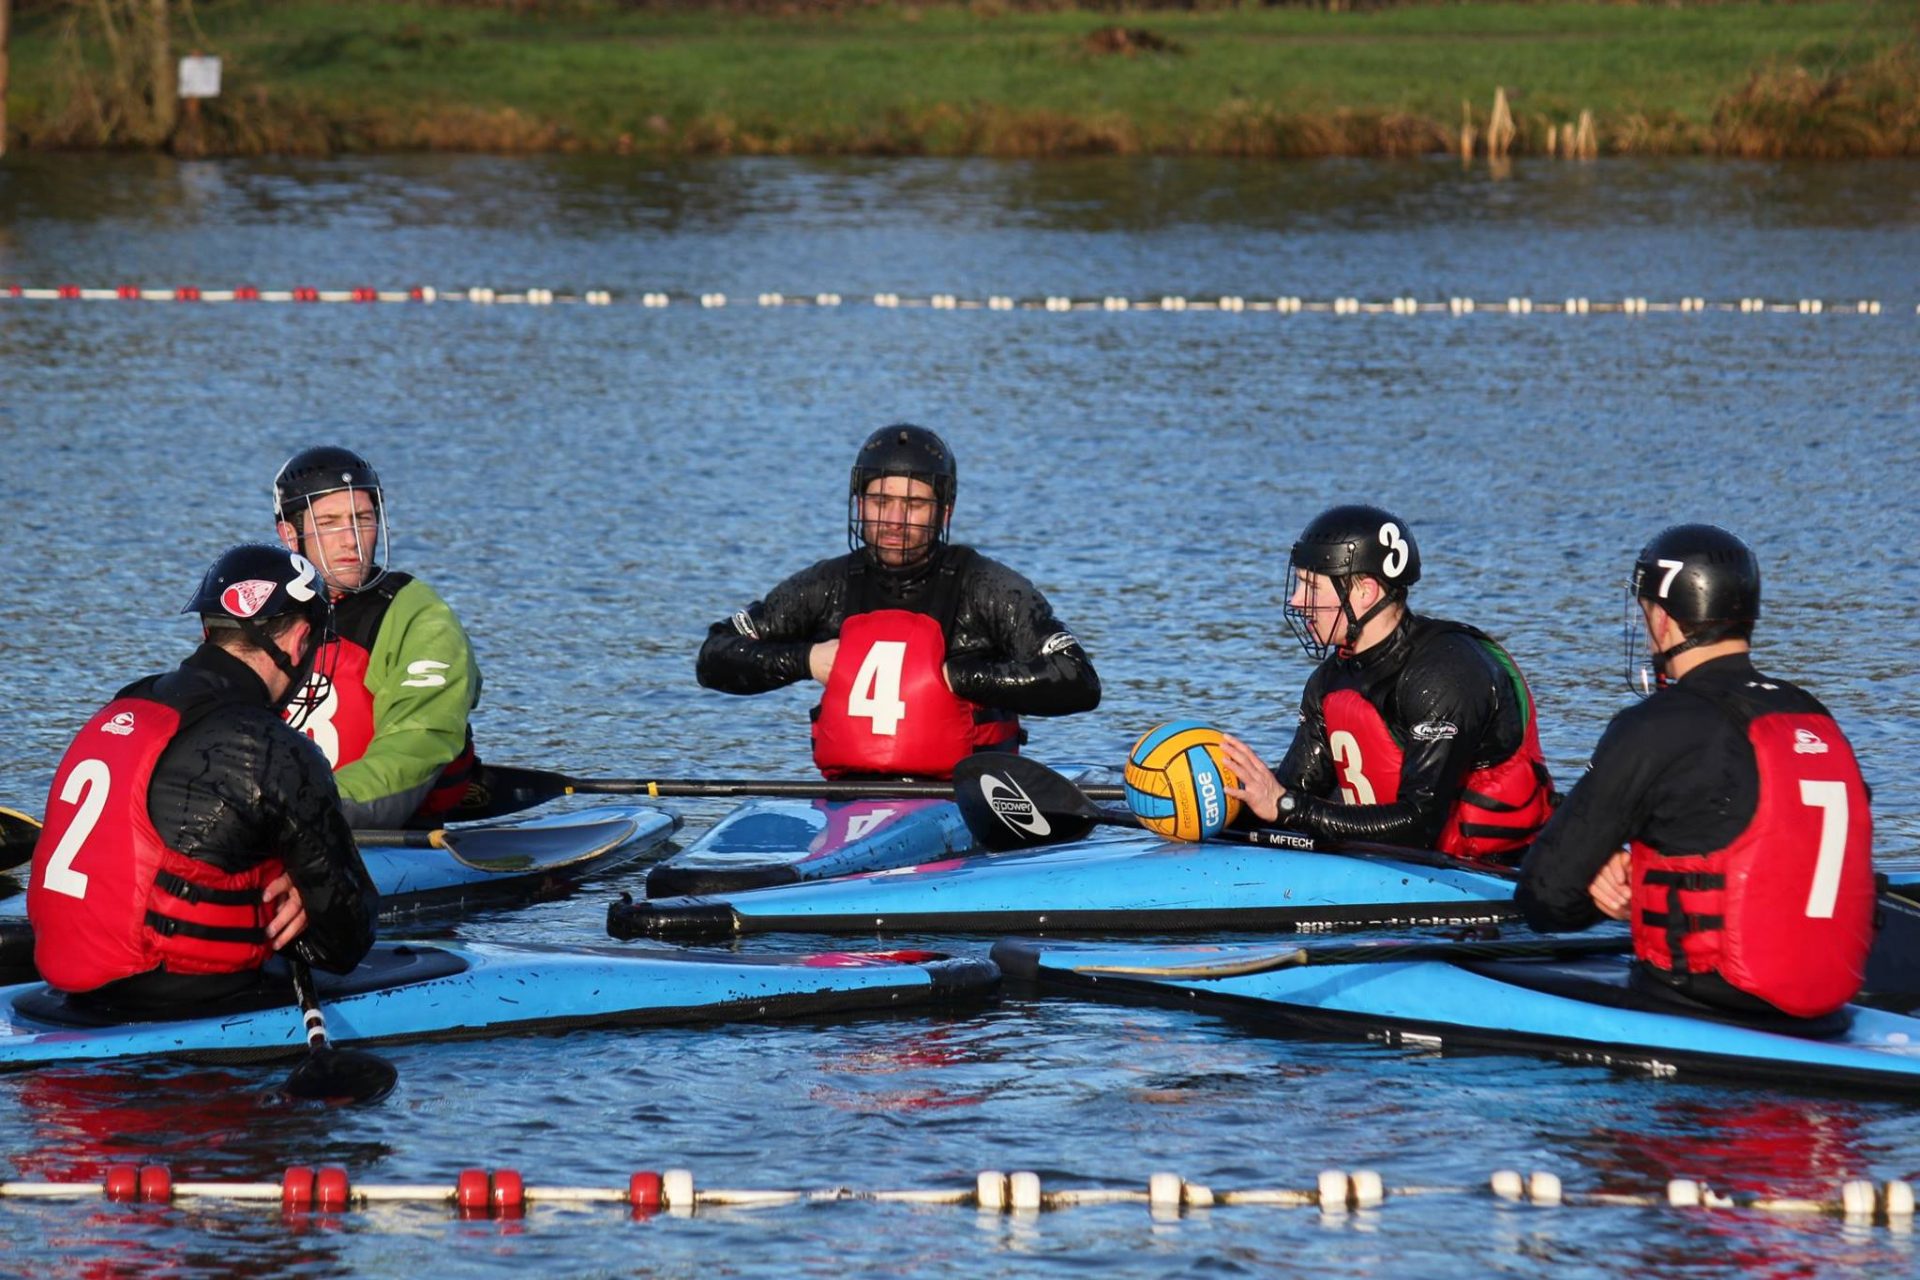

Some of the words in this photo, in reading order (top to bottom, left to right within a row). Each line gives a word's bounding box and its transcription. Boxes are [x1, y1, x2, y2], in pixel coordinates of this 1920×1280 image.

[285, 553, 316, 602] 2
[1379, 522, 1409, 578] 3
[1657, 559, 1684, 598] 7
[848, 640, 907, 736] 4
[1330, 730, 1377, 805] 3
[1198, 771, 1219, 827] canoe
[43, 759, 111, 900] 2
[1269, 833, 1314, 849] MFTECH
[1799, 779, 1849, 919] 7
